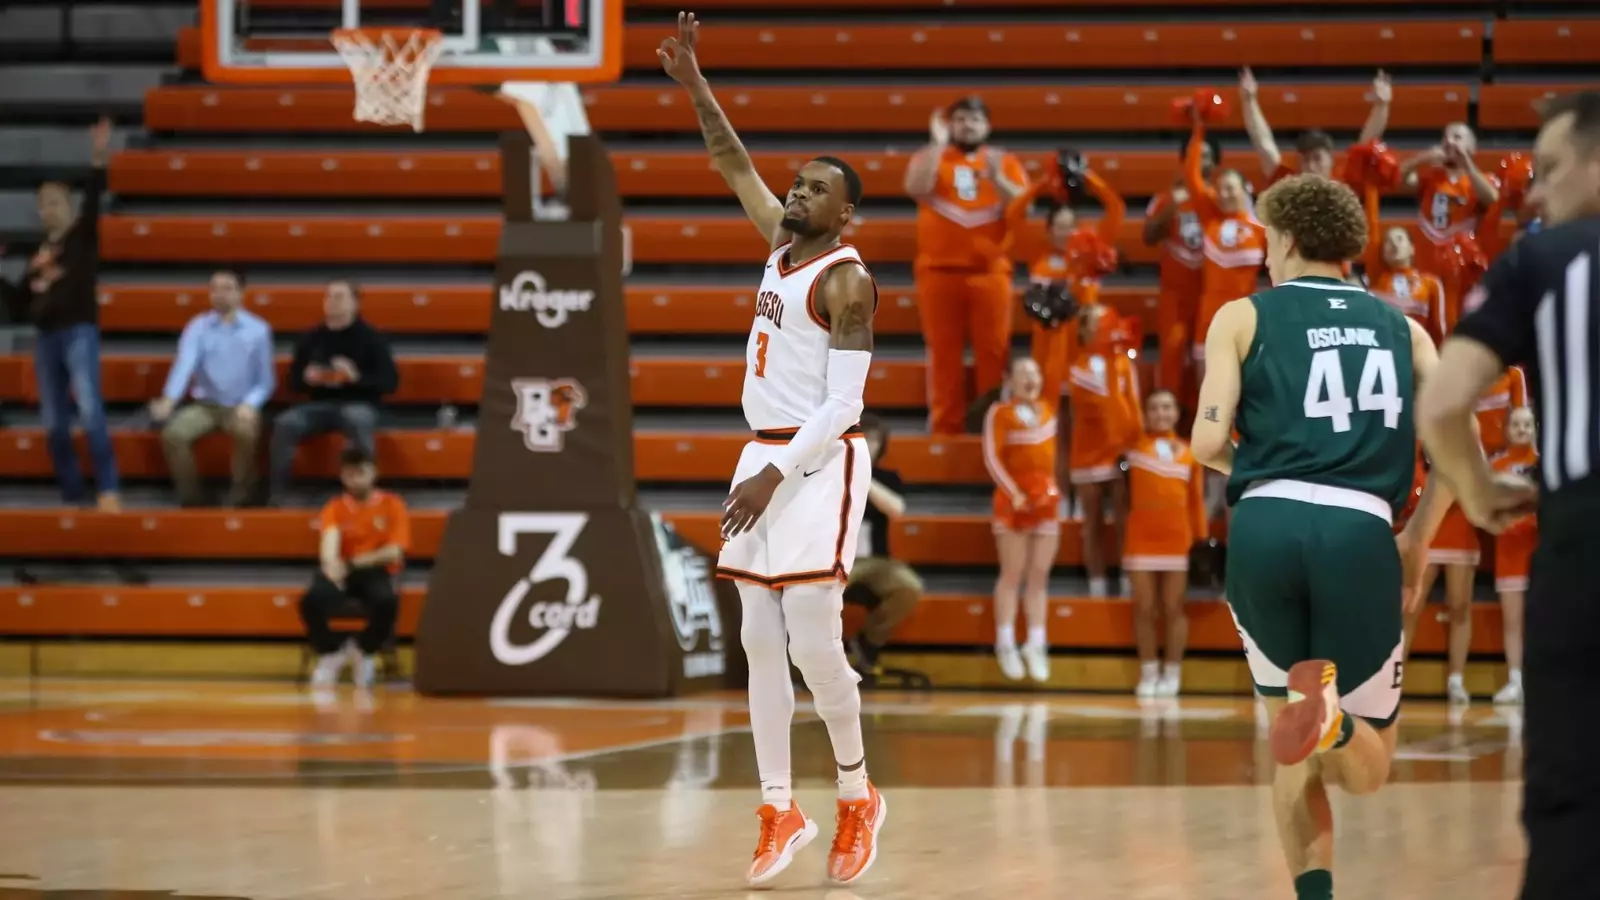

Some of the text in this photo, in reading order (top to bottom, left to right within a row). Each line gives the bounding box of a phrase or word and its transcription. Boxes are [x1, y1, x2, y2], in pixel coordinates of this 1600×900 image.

[500, 270, 595, 328] Kroger
[755, 291, 784, 330] BGSU
[1327, 298, 1347, 310] E
[754, 331, 770, 378] 3
[1306, 327, 1379, 350] OSOJNIK
[1303, 349, 1403, 433] 44
